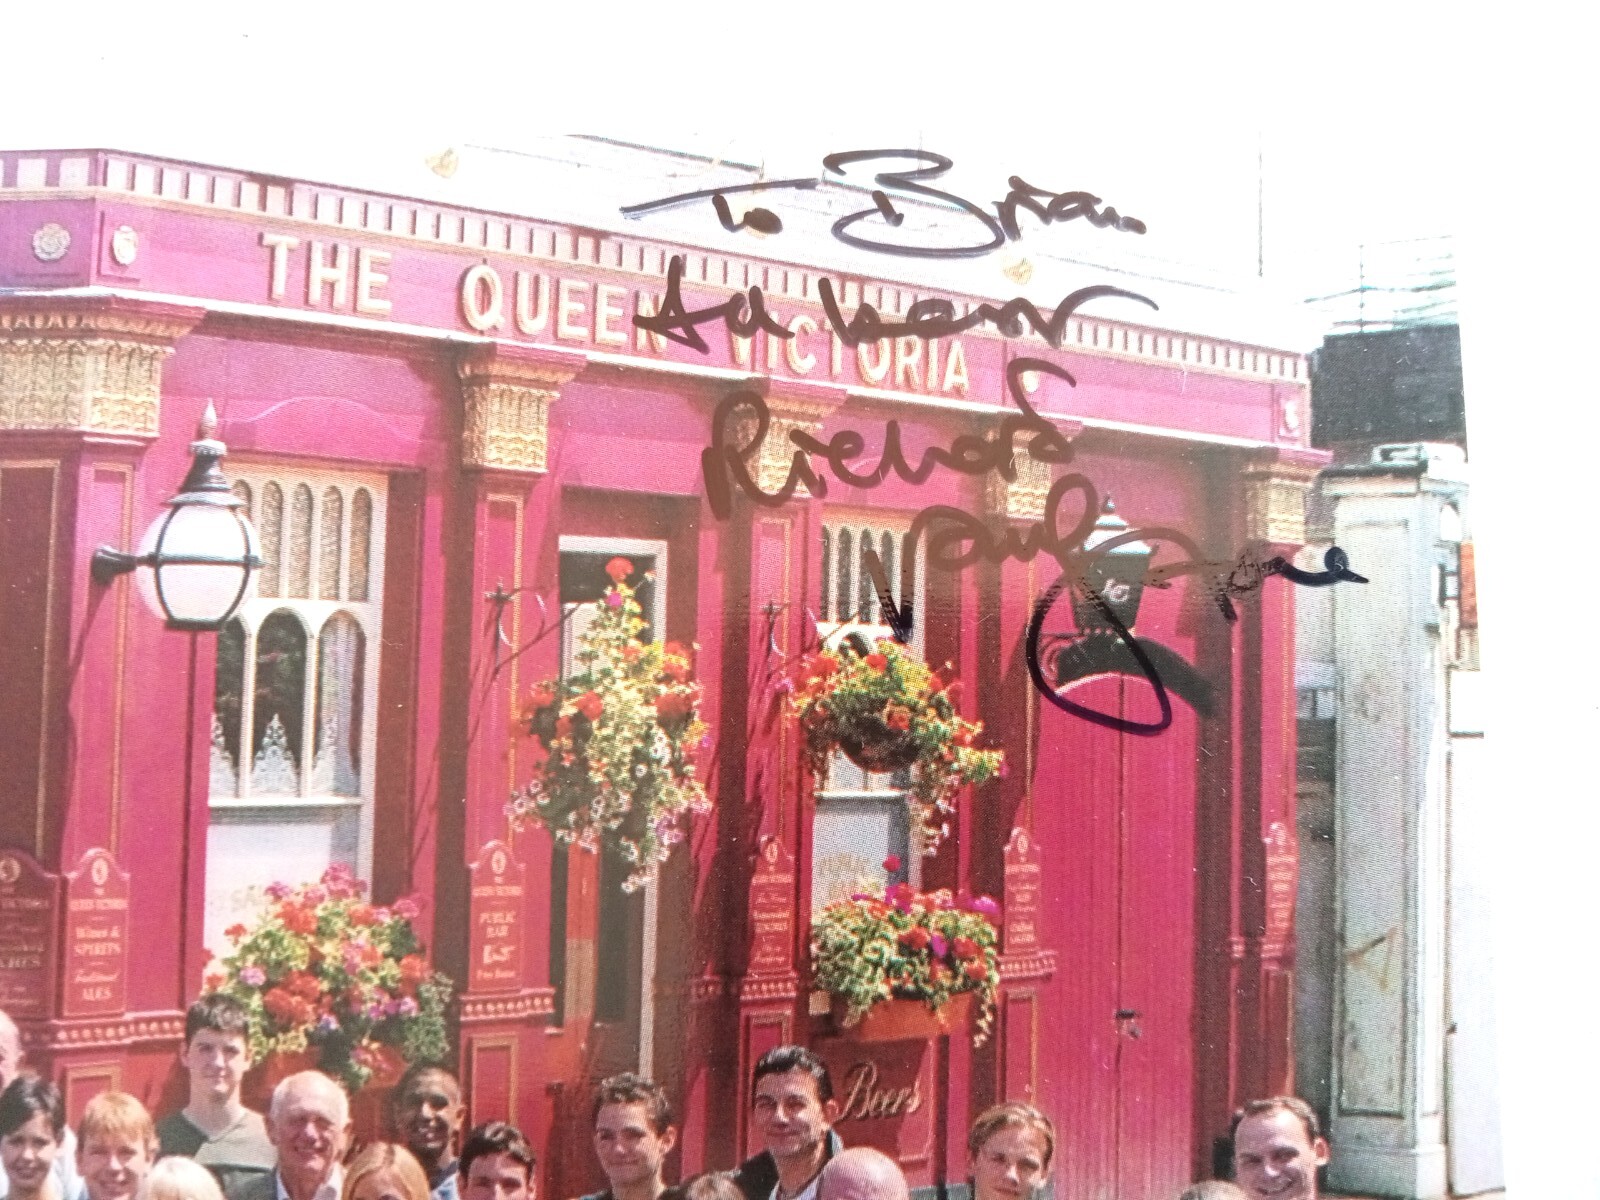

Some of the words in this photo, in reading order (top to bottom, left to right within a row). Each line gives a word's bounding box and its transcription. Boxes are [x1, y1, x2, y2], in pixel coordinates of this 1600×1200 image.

[619, 177, 818, 236] To
[823, 148, 1148, 259] Brian
[257, 233, 393, 314] THE
[459, 257, 673, 352] QUEEN
[730, 306, 970, 396] VICTORIA
[835, 1060, 922, 1120] Beers
